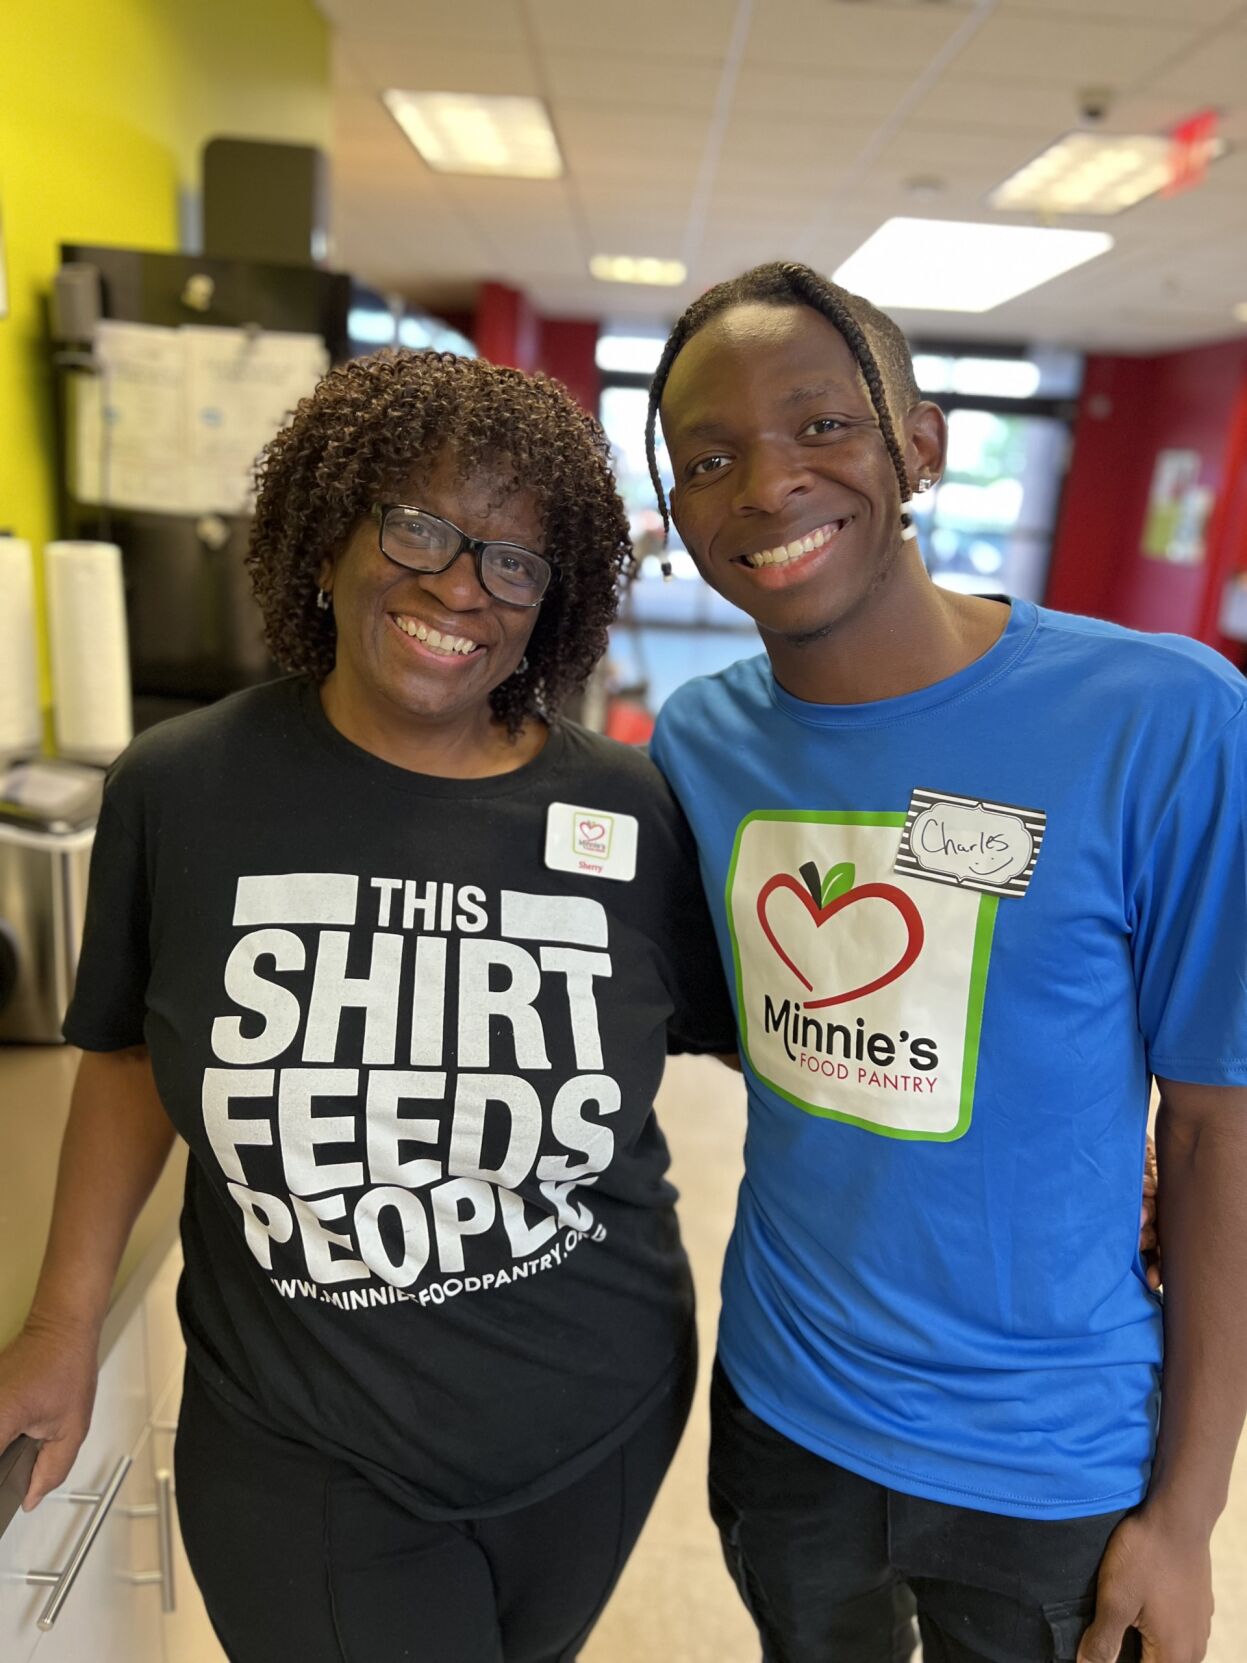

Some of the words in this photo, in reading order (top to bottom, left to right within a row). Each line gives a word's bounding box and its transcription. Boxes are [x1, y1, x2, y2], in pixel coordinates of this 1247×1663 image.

[921, 818, 1009, 856] Charles
[578, 861, 603, 873] Sherry
[370, 878, 489, 932] THIS
[211, 929, 613, 1070] SHIRT
[764, 993, 939, 1071] Minnie's
[800, 1053, 849, 1080] FOOD
[858, 1068, 938, 1094] PANTRY
[202, 1068, 621, 1196] FEEDS
